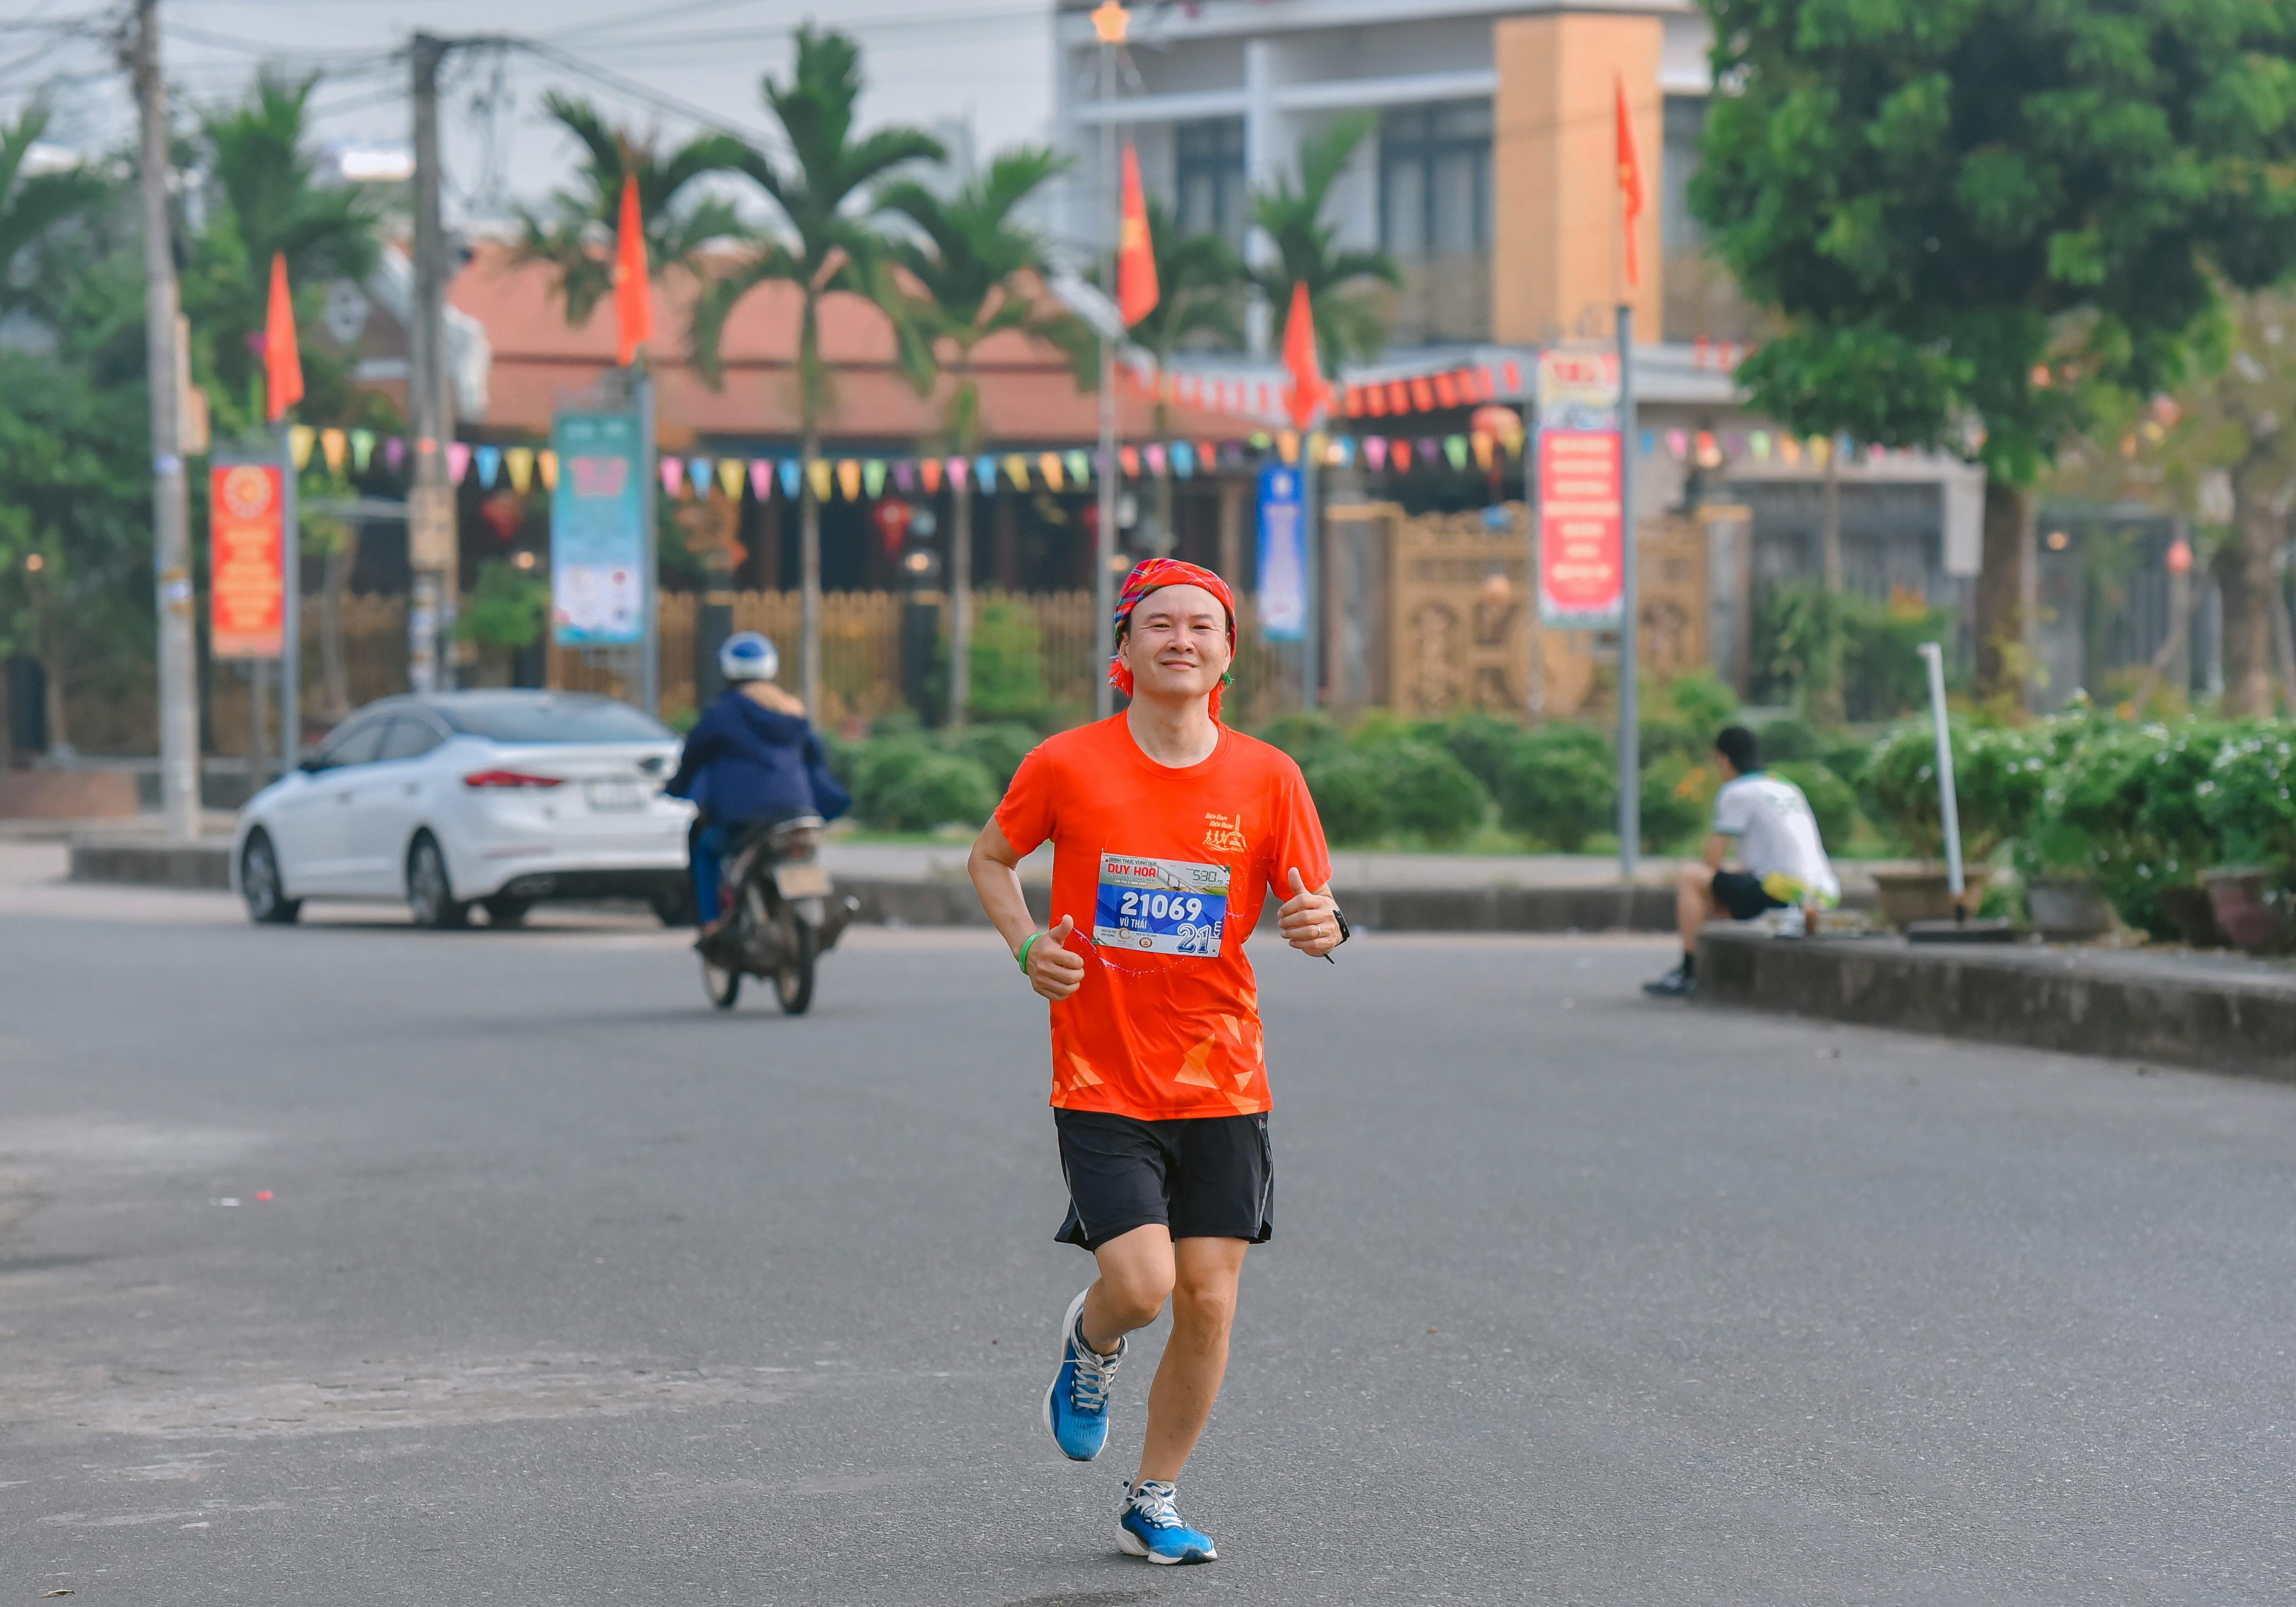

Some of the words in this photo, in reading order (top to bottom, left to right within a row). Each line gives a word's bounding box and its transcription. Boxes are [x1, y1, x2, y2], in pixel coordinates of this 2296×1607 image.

[1107, 863, 1131, 875] DUY
[1120, 891, 1202, 921] 21069
[1120, 916, 1129, 927] VŨ
[1131, 918, 1147, 929] THÁI
[1213, 921, 1223, 939] km
[1176, 923, 1212, 954] 21
